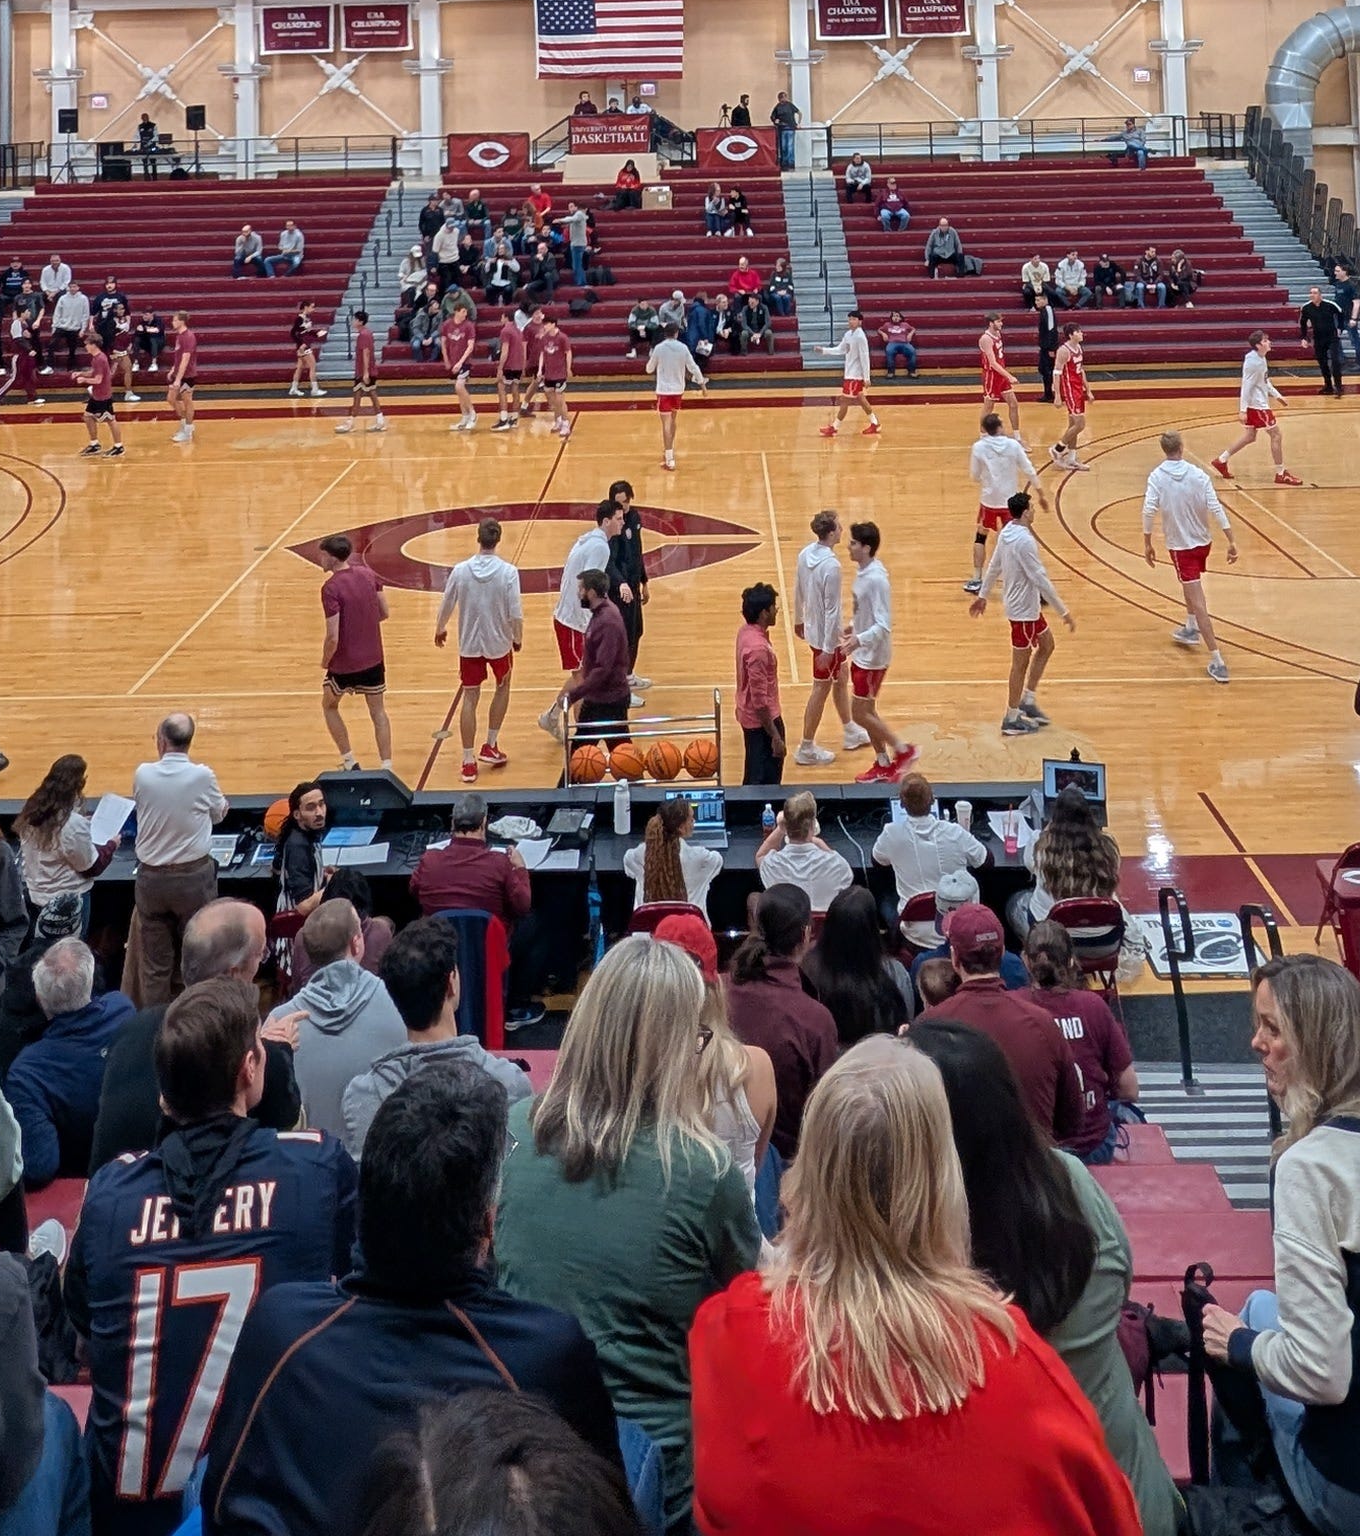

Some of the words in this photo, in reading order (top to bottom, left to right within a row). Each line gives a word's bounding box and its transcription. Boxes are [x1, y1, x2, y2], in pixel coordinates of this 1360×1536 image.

[827, 6, 877, 15] CHAMPIONS
[907, 5, 957, 14] CHAMPIONS
[571, 132, 648, 144] BASKETBALL
[130, 1180, 277, 1247] JEERY
[116, 1256, 264, 1500] 17
